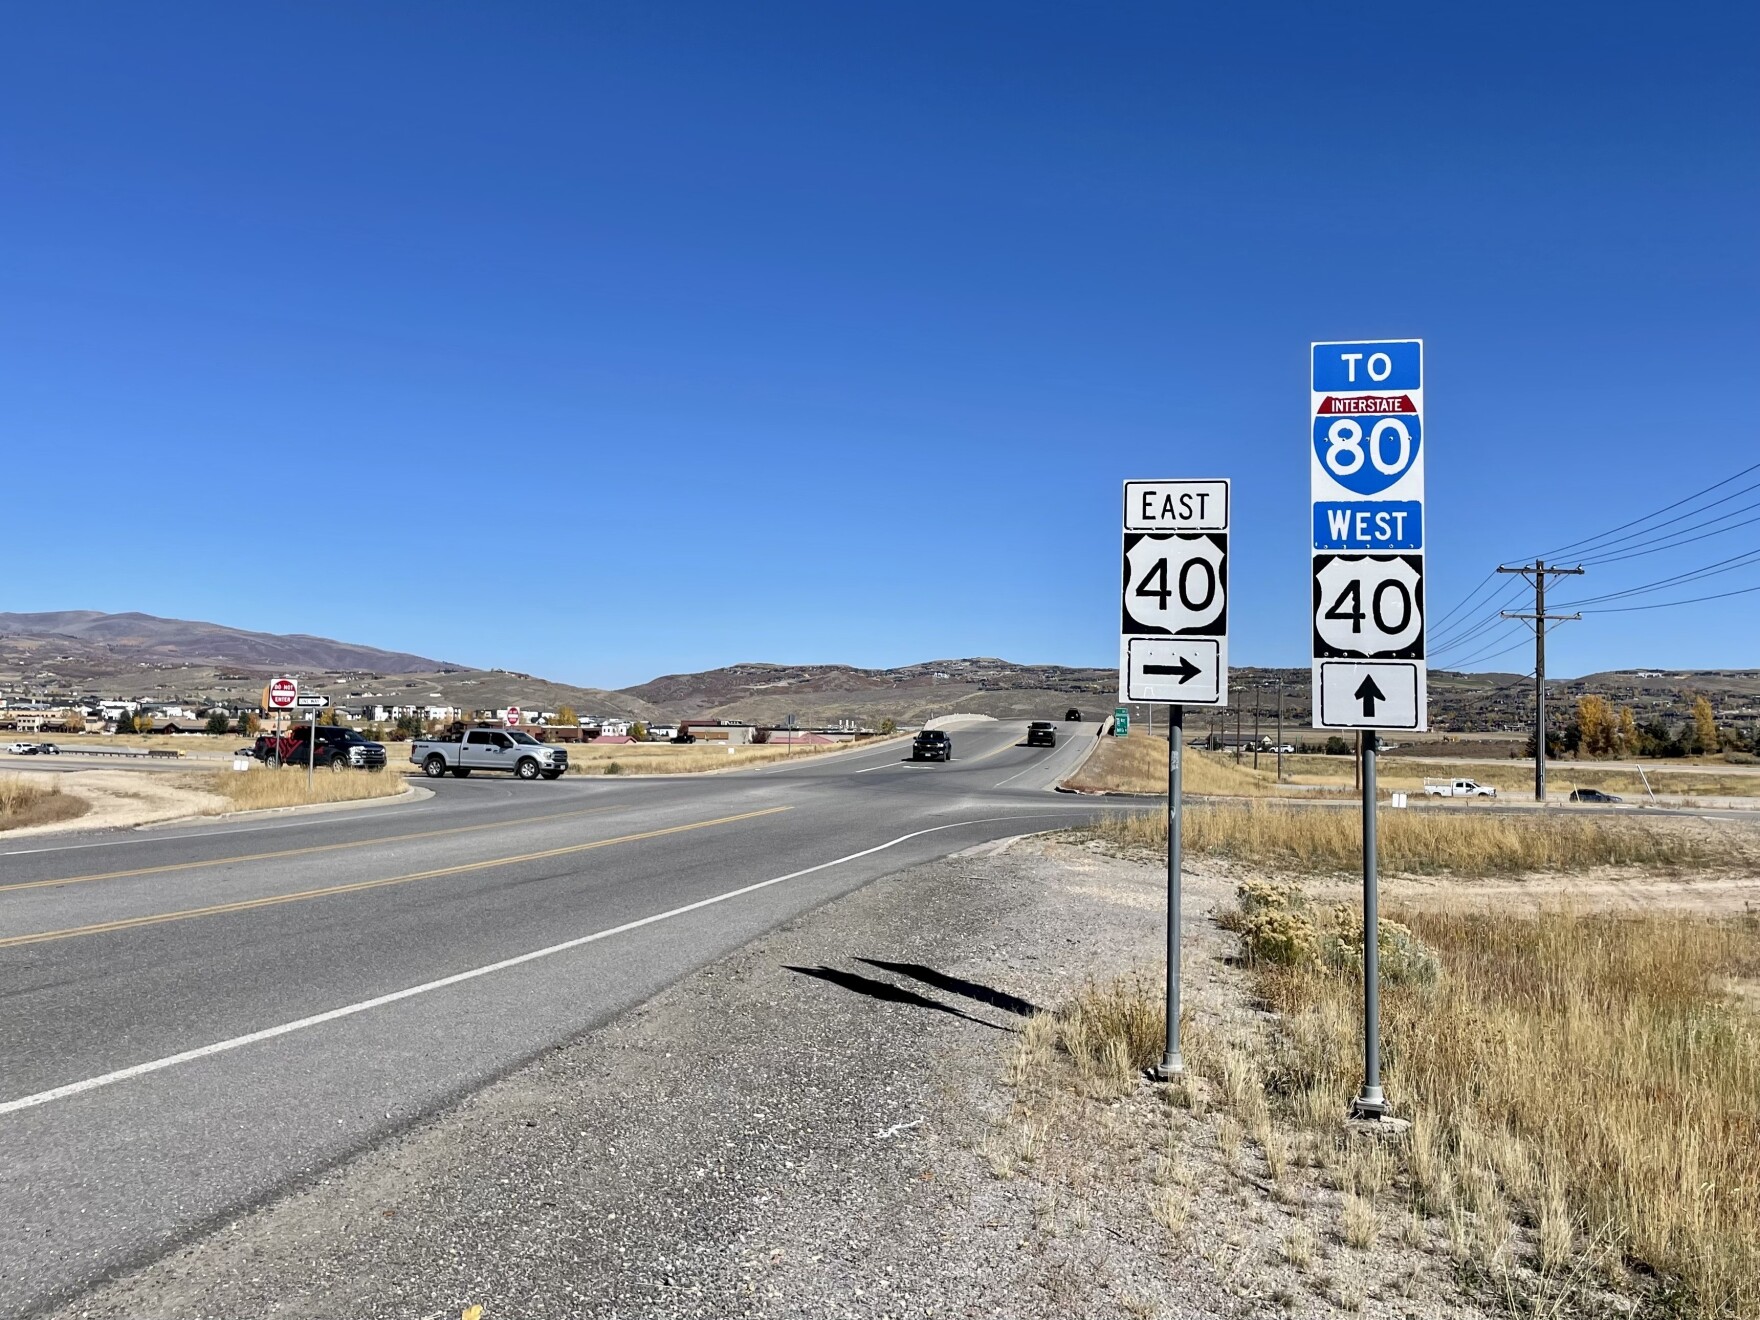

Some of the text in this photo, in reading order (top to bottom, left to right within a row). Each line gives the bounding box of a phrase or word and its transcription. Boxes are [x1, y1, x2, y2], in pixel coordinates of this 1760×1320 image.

[1341, 352, 1392, 382] TO
[1331, 398, 1403, 413] INTERSTATE
[1326, 417, 1411, 476] 80
[1142, 491, 1210, 520] EAST
[1327, 509, 1408, 541] WEST
[1135, 556, 1216, 612] 40
[1324, 578, 1412, 635] 40
